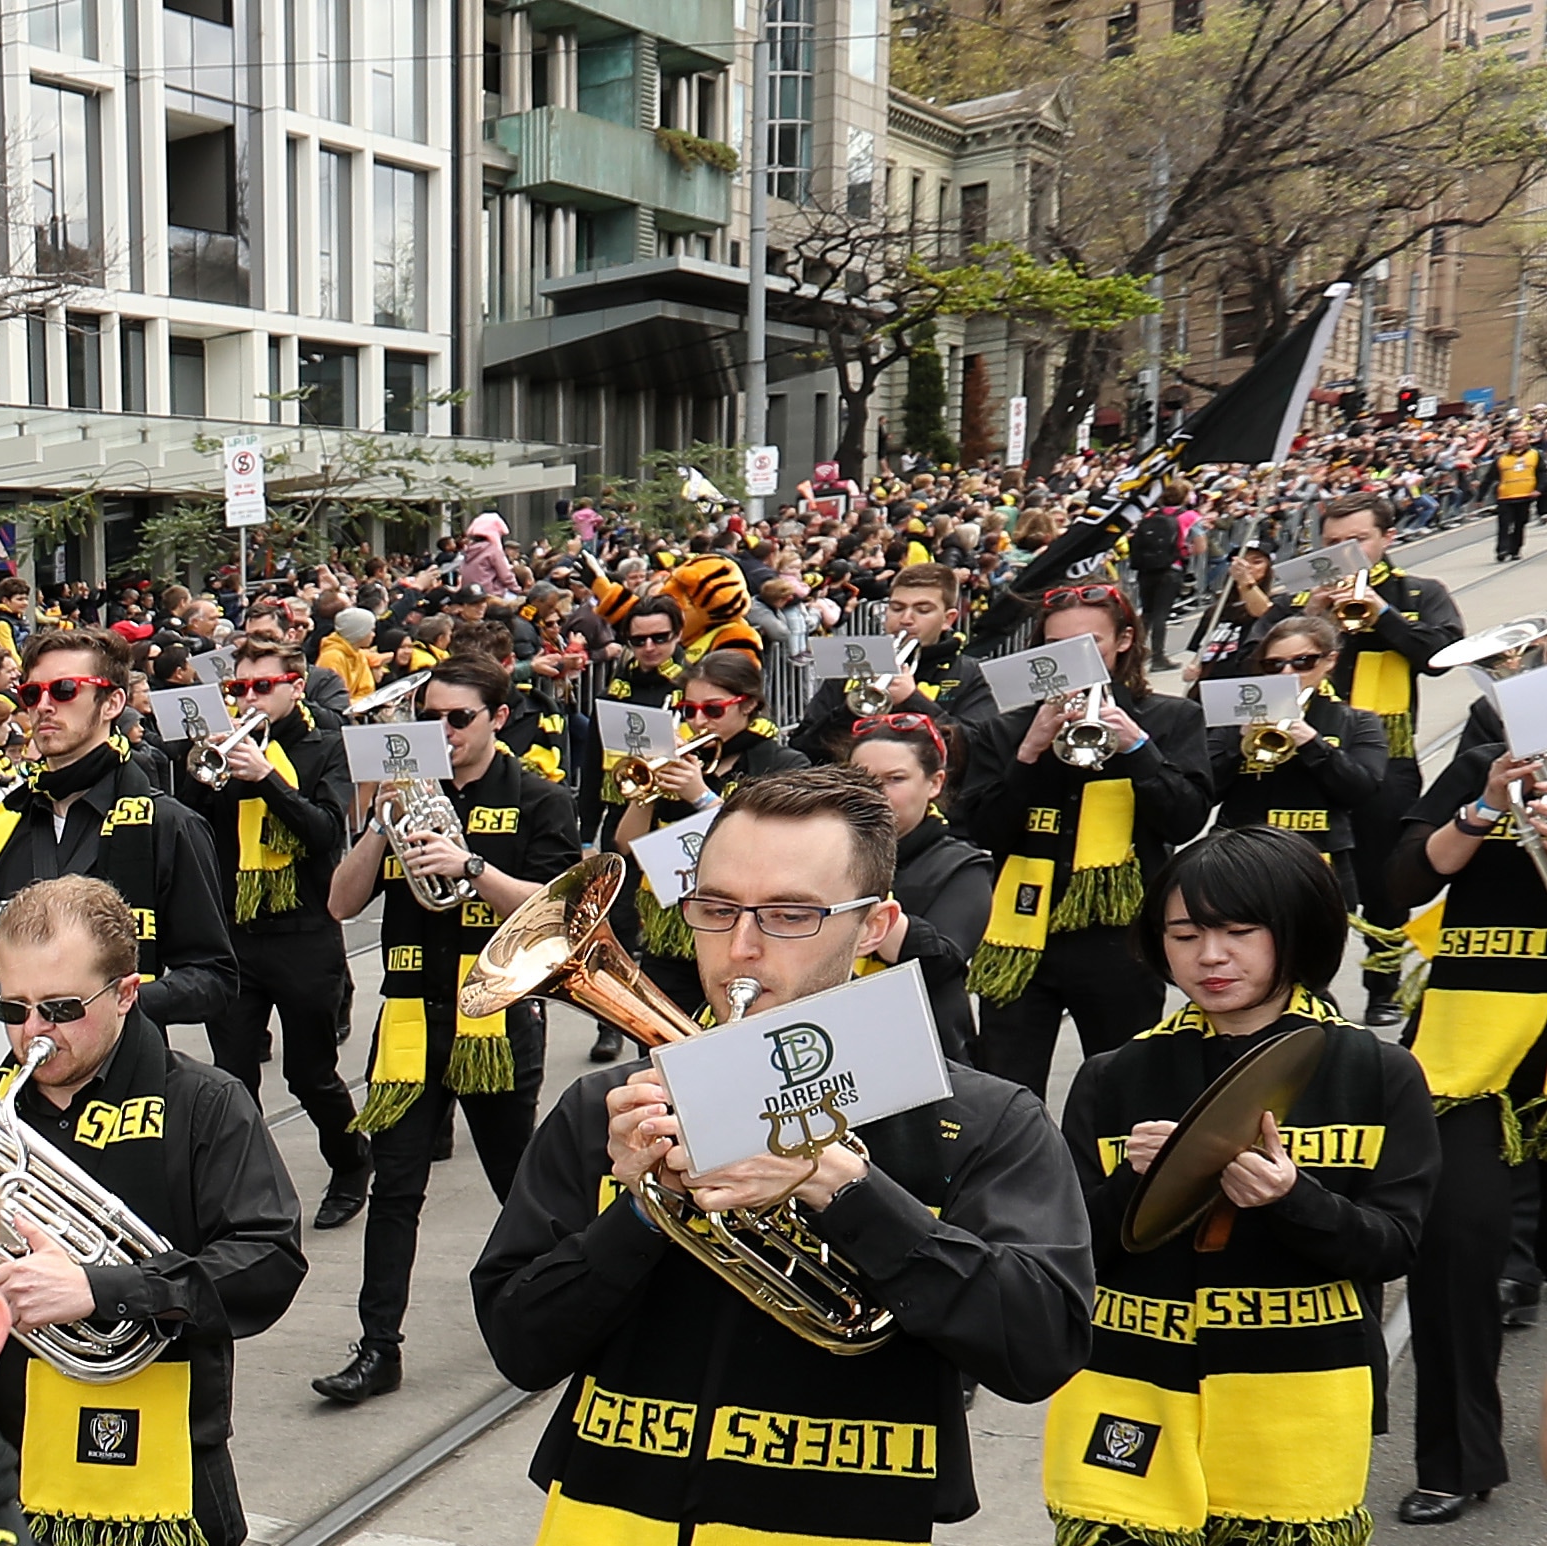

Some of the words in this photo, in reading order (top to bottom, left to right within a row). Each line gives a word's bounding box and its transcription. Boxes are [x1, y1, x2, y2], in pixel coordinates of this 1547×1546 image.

[473, 809, 519, 830] ERS
[1272, 811, 1329, 829] TIGE
[391, 947, 423, 969] TIGE
[764, 1071, 855, 1114] DAREBIN
[1280, 1128, 1367, 1164] TIGE
[1093, 1289, 1189, 1340] TIGER
[1206, 1282, 1358, 1325] TIGERS
[581, 1391, 694, 1453] GERS
[724, 1410, 936, 1475] TIGERS
